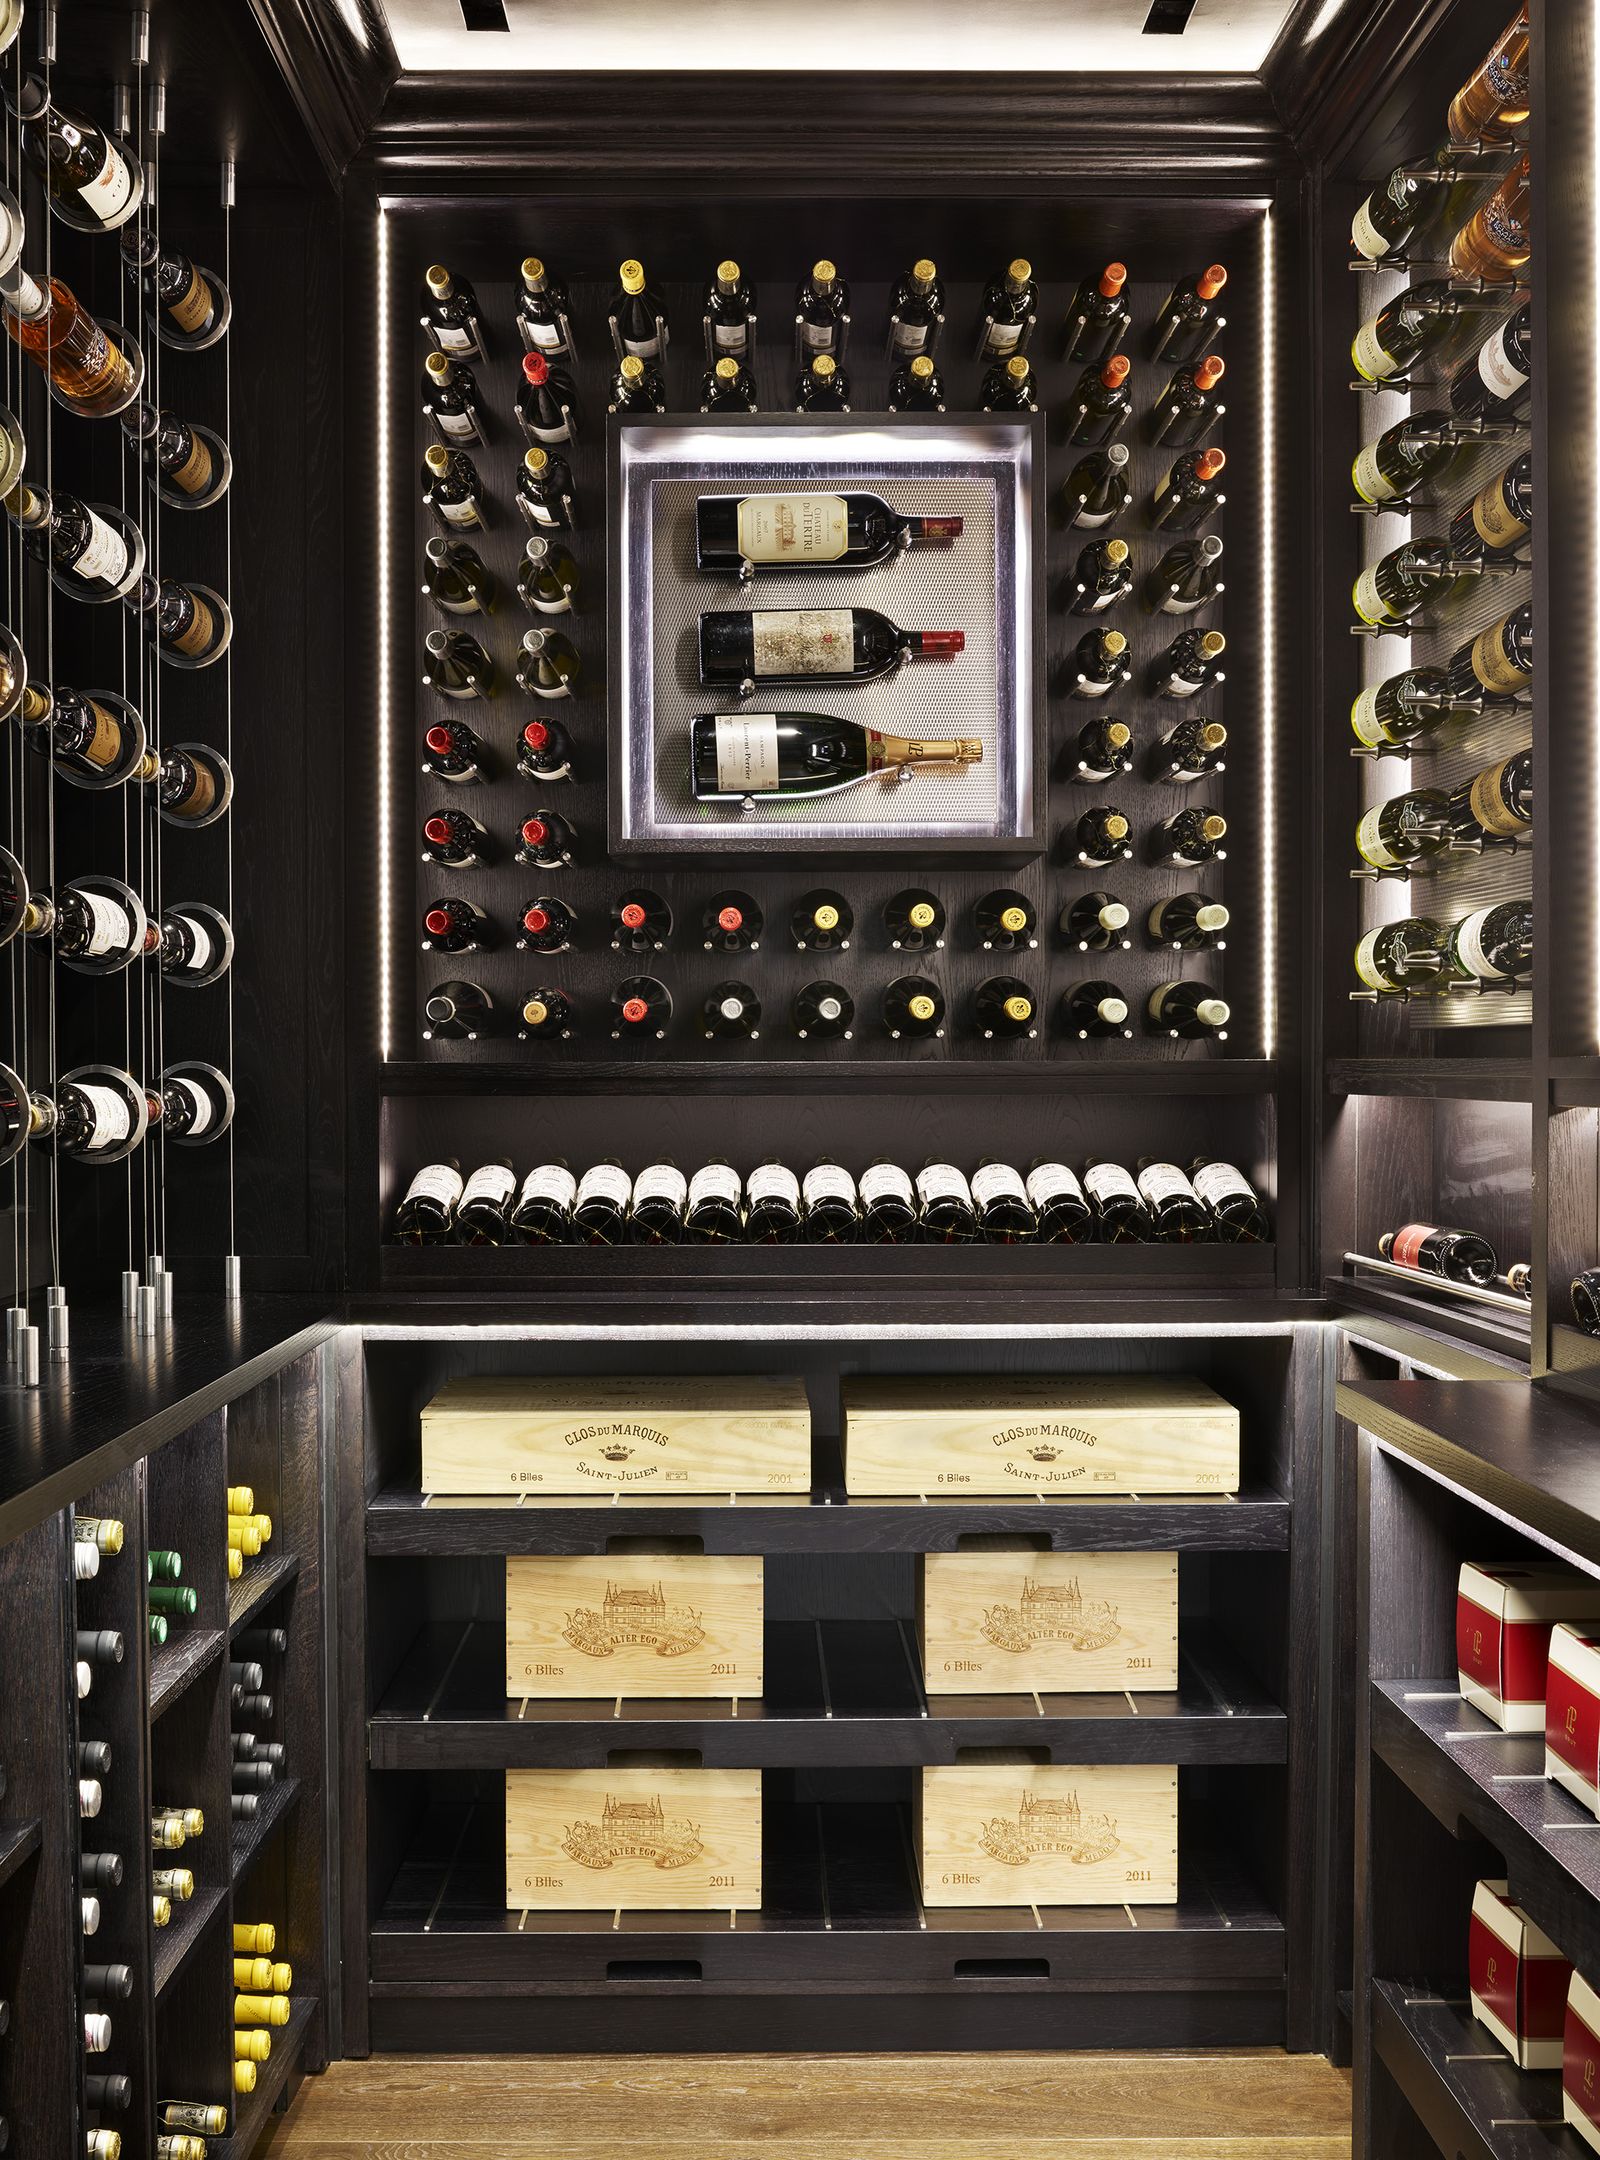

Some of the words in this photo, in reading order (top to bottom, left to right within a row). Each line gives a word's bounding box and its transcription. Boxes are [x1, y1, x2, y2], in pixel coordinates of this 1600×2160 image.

[804, 513, 813, 552] TERTRE
[743, 722, 752, 780] Laurent-Perrier
[564, 1426, 597, 1446] CLOS
[597, 1426, 610, 1436] DU
[611, 1424, 669, 1447] MARQUIS
[992, 1426, 1025, 1447] CLOS
[1025, 1427, 1038, 1436] DU
[1040, 1425, 1098, 1447] MARQUIS
[510, 1472, 517, 1482] 6
[767, 1472, 793, 1485] 2001
[937, 1473, 944, 1483] 6
[1195, 1473, 1221, 1485] 2001
[610, 1634, 638, 1645] ALTER
[641, 1634, 658, 1645] EGO
[985, 1627, 1023, 1650] MARGAUX
[1027, 1629, 1054, 1640] ALTER
[1057, 1629, 1074, 1640] EGO
[566, 1630, 605, 1655] MARGAUX
[944, 1661, 951, 1672] 6
[1126, 1657, 1152, 1668] 2011
[525, 1664, 532, 1675] 6
[711, 1663, 737, 1674] 2011
[609, 1846, 636, 1857] ALTER
[639, 1846, 657, 1857] EGO
[984, 1840, 1022, 1863] MARGAUX
[1026, 1842, 1053, 1854] ALTER
[1056, 1842, 1073, 1853] EGO
[566, 1842, 604, 1867] MARGAUX
[709, 1876, 735, 1887] 2011
[942, 1873, 949, 1884] 6
[1126, 1870, 1151, 1882] 2011
[525, 1877, 532, 1887] 6
